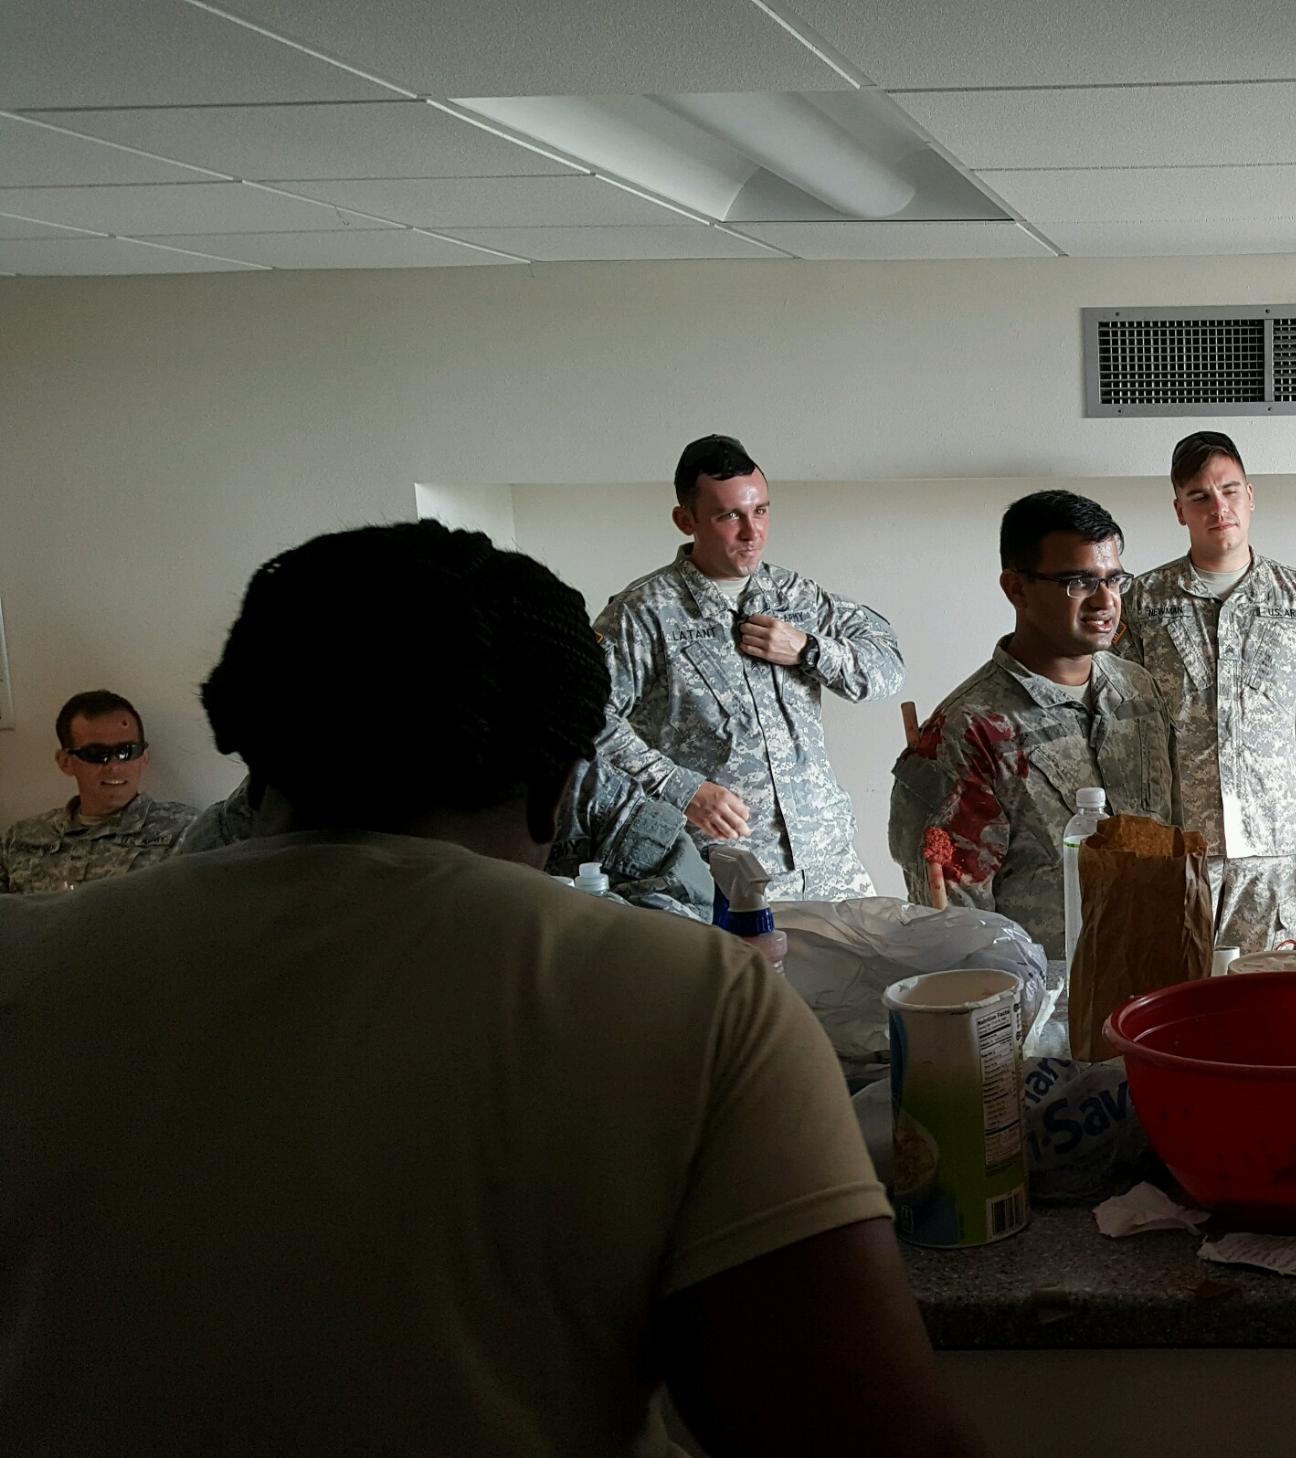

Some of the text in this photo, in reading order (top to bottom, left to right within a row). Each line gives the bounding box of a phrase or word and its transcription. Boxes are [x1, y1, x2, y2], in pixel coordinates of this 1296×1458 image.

[783, 611, 804, 623] ARMY
[1148, 606, 1183, 617] NEWMAN
[672, 627, 717, 641] LATANT
[1044, 1080, 1128, 1155] Sav
